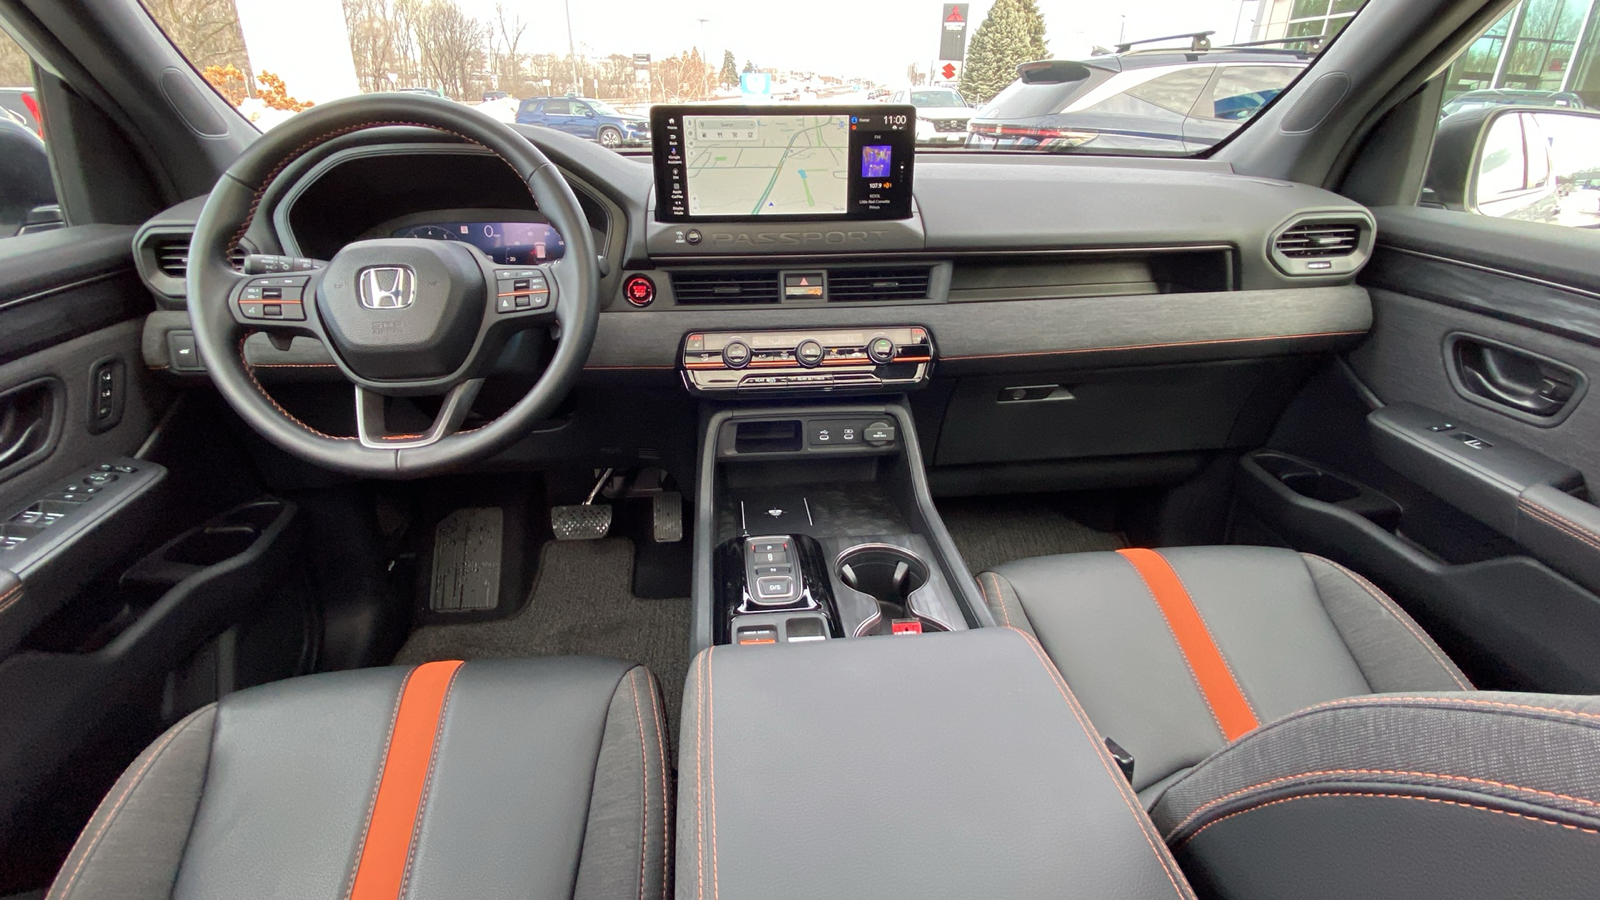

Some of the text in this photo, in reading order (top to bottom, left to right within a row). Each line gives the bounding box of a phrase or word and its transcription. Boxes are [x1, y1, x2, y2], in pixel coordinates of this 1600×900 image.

[883, 115, 906, 125] 11:00
[484, 225, 494, 237] 0
[711, 230, 890, 246] PASSPORT
